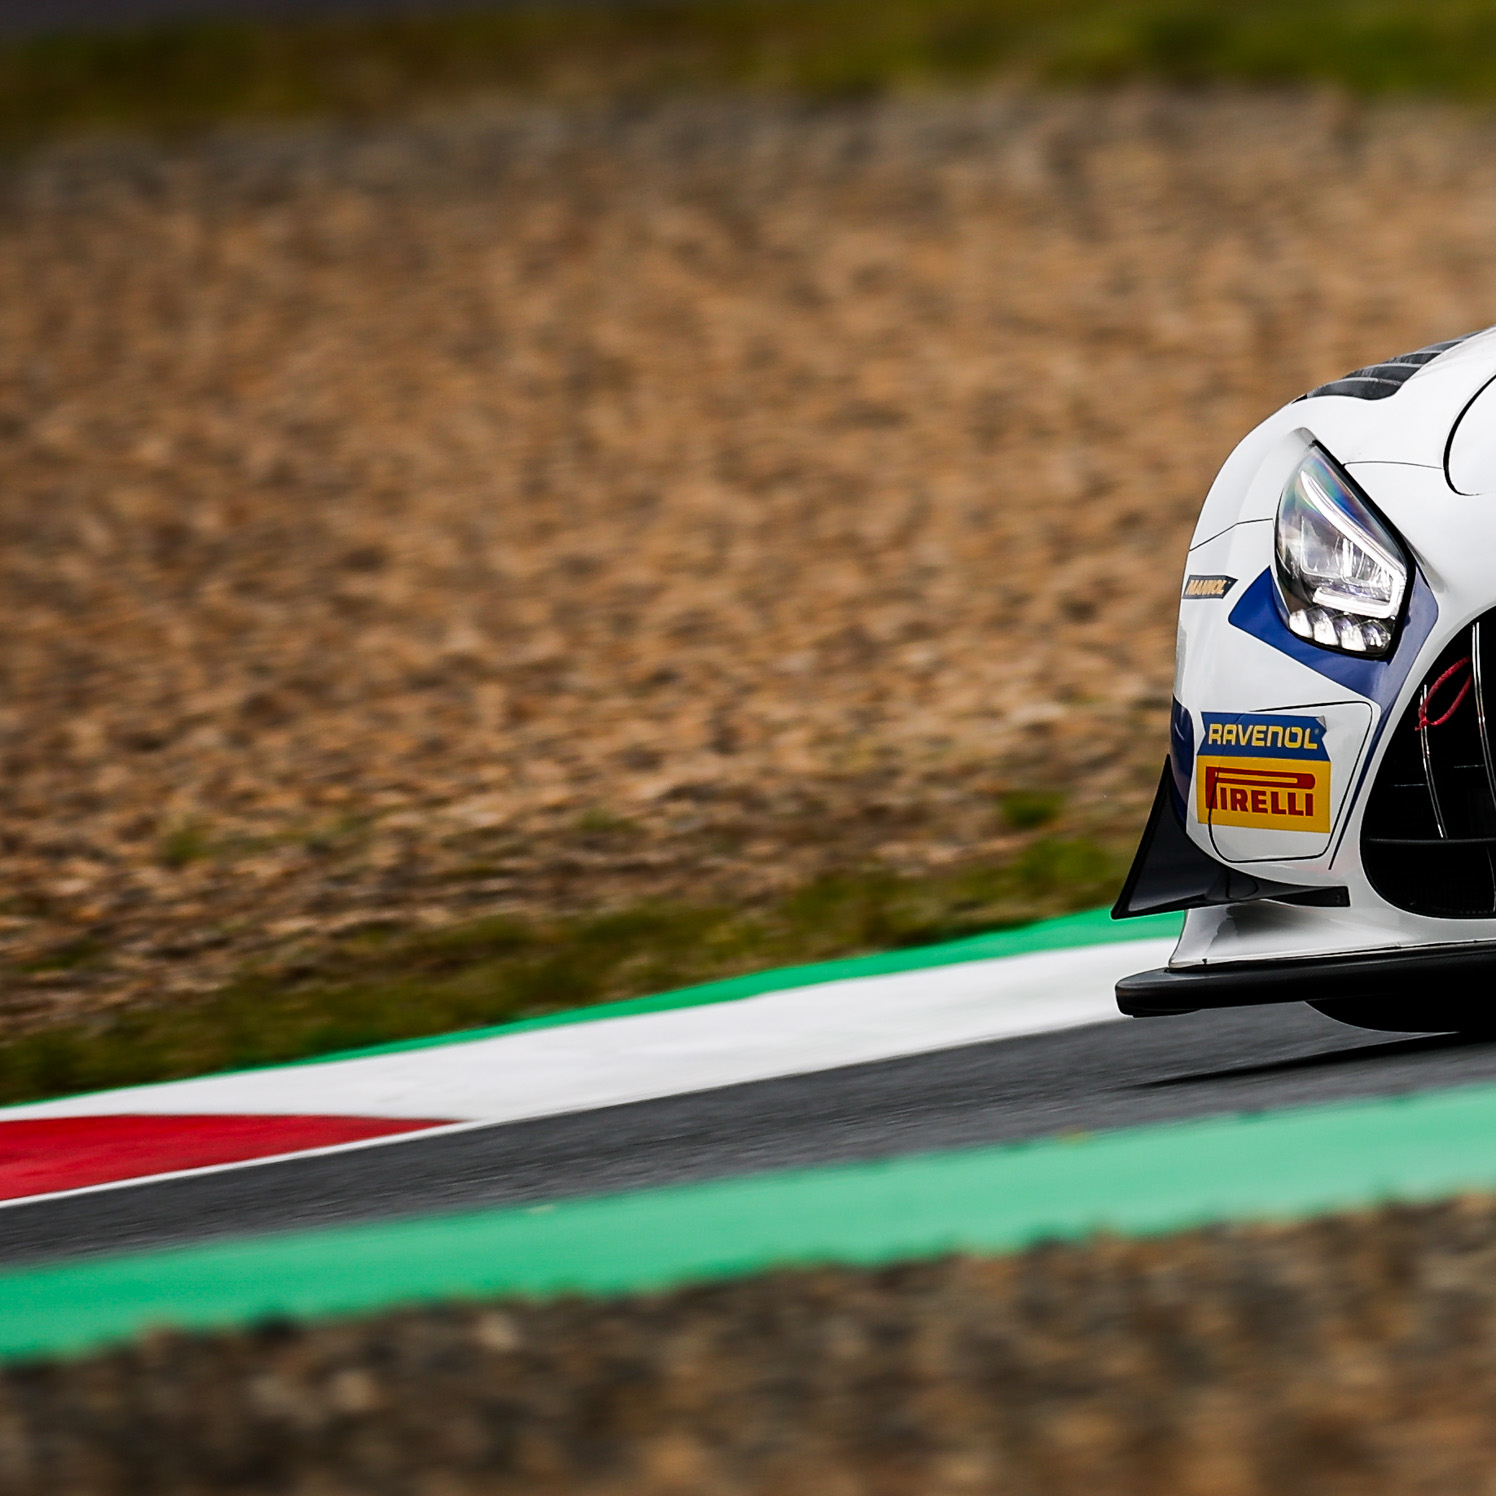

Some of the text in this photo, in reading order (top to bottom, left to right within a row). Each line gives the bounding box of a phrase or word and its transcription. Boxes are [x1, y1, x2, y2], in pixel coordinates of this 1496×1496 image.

[1184, 578, 1226, 596] MANNOL
[1207, 722, 1318, 750] RAVENOL
[1205, 765, 1316, 818] PIRELLI
